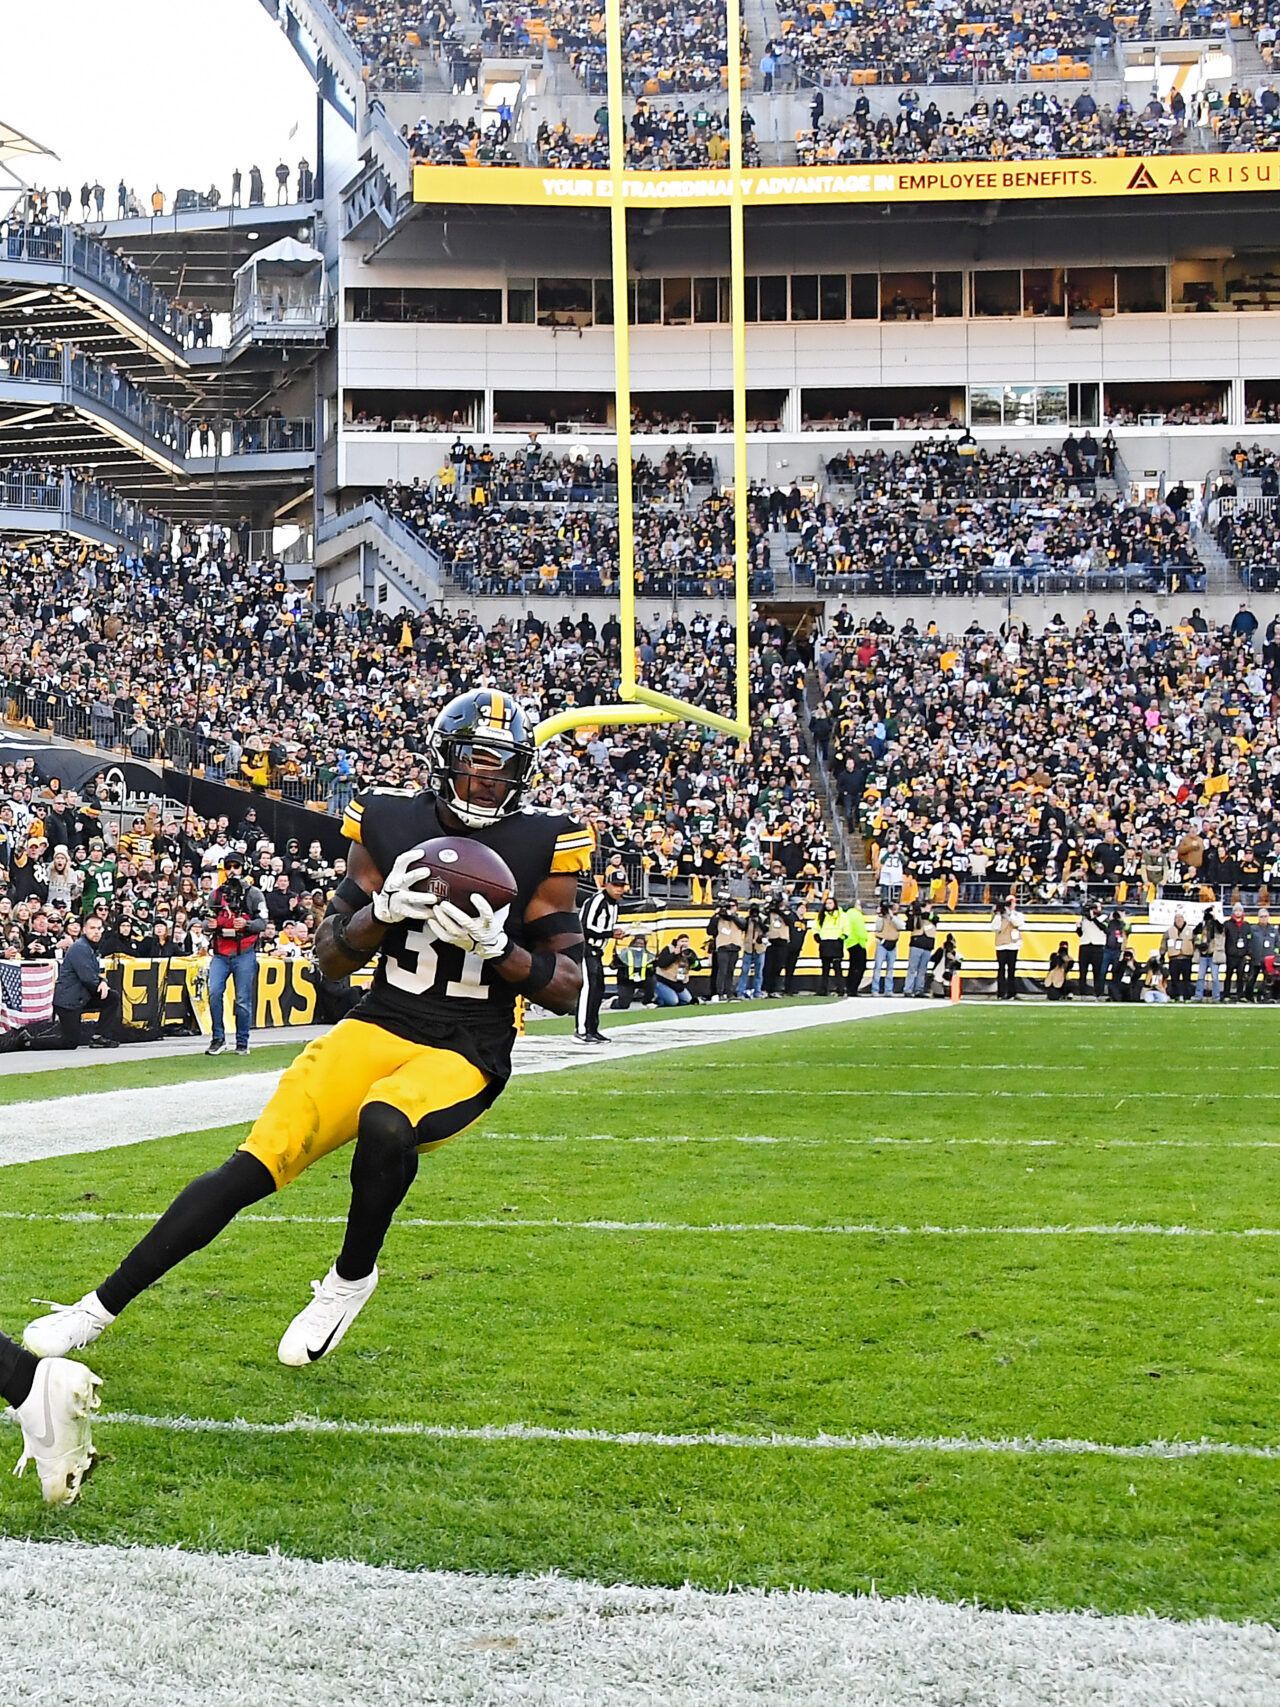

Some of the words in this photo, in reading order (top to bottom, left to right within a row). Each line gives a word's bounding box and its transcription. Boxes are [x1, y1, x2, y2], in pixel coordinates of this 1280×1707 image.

[542, 178, 592, 197] YOUR
[596, 178, 750, 198] ETRAORDINAY
[756, 174, 871, 195] ADVANTAGE
[874, 174, 895, 192] IN
[898, 172, 997, 190] EMPLOYEE
[1002, 170, 1097, 188] BENEFITS.
[1168, 165, 1280, 185] ACRISU
[478, 704, 512, 730] 31
[808, 847, 827, 862] 75
[918, 860, 934, 875] 75
[95, 871, 114, 893] 12
[259, 875, 275, 893] 90
[384, 927, 491, 1000] 31
